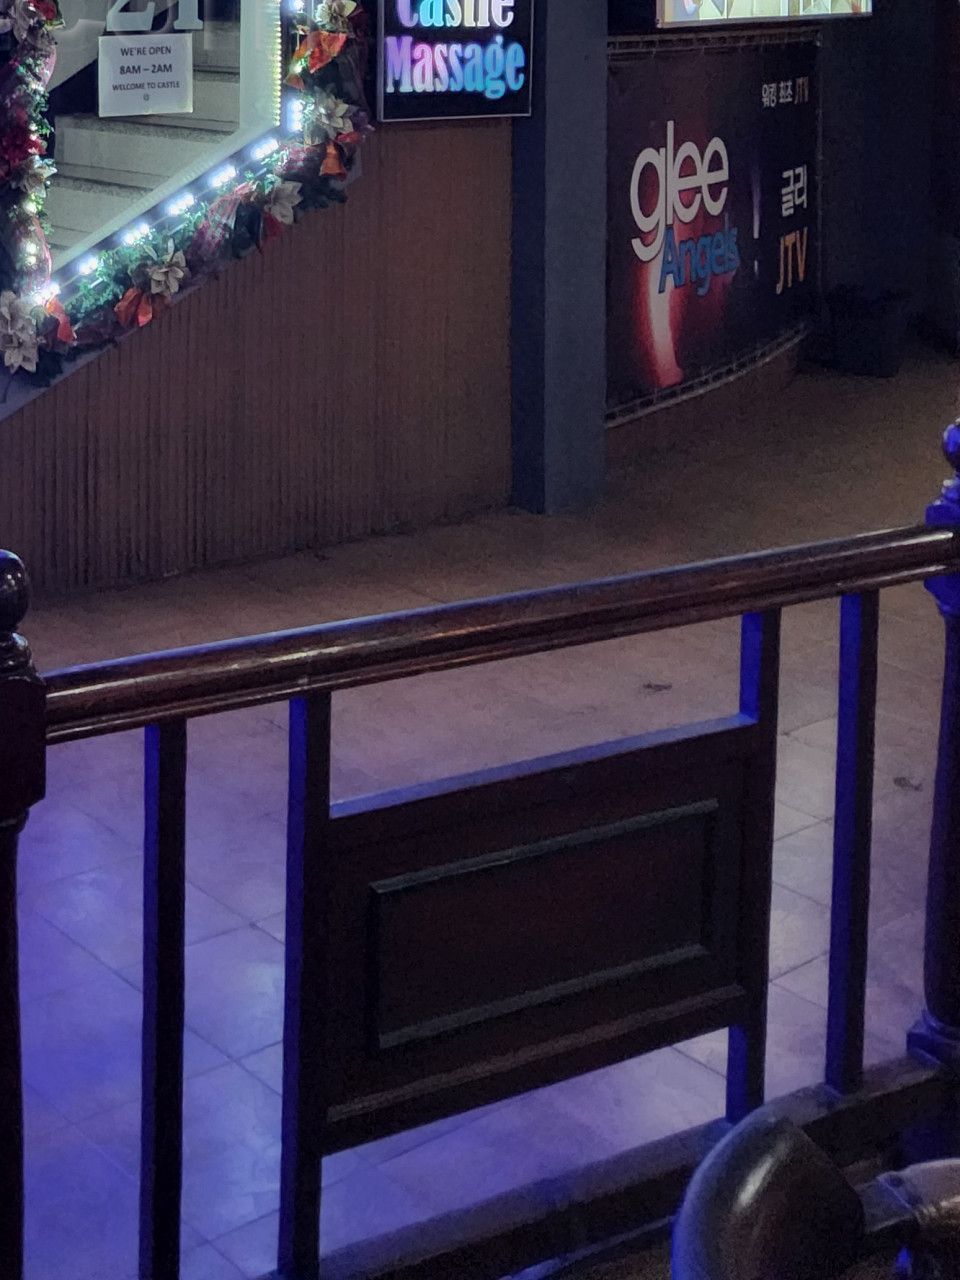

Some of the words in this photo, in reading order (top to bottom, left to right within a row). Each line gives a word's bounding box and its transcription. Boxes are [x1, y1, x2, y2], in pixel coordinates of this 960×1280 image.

[120, 47, 147, 57] WE'RE
[149, 46, 172, 55] OPEN
[120, 65, 142, 75] 8AM
[152, 64, 173, 74] 2AM
[386, 35, 526, 99] Massage
[112, 83, 145, 91] WELCOME
[158, 81, 180, 89] CASTLE
[630, 120, 730, 262] glee
[781, 164, 808, 217] 글리
[658, 218, 740, 296] Angels
[775, 227, 808, 295] JTV
